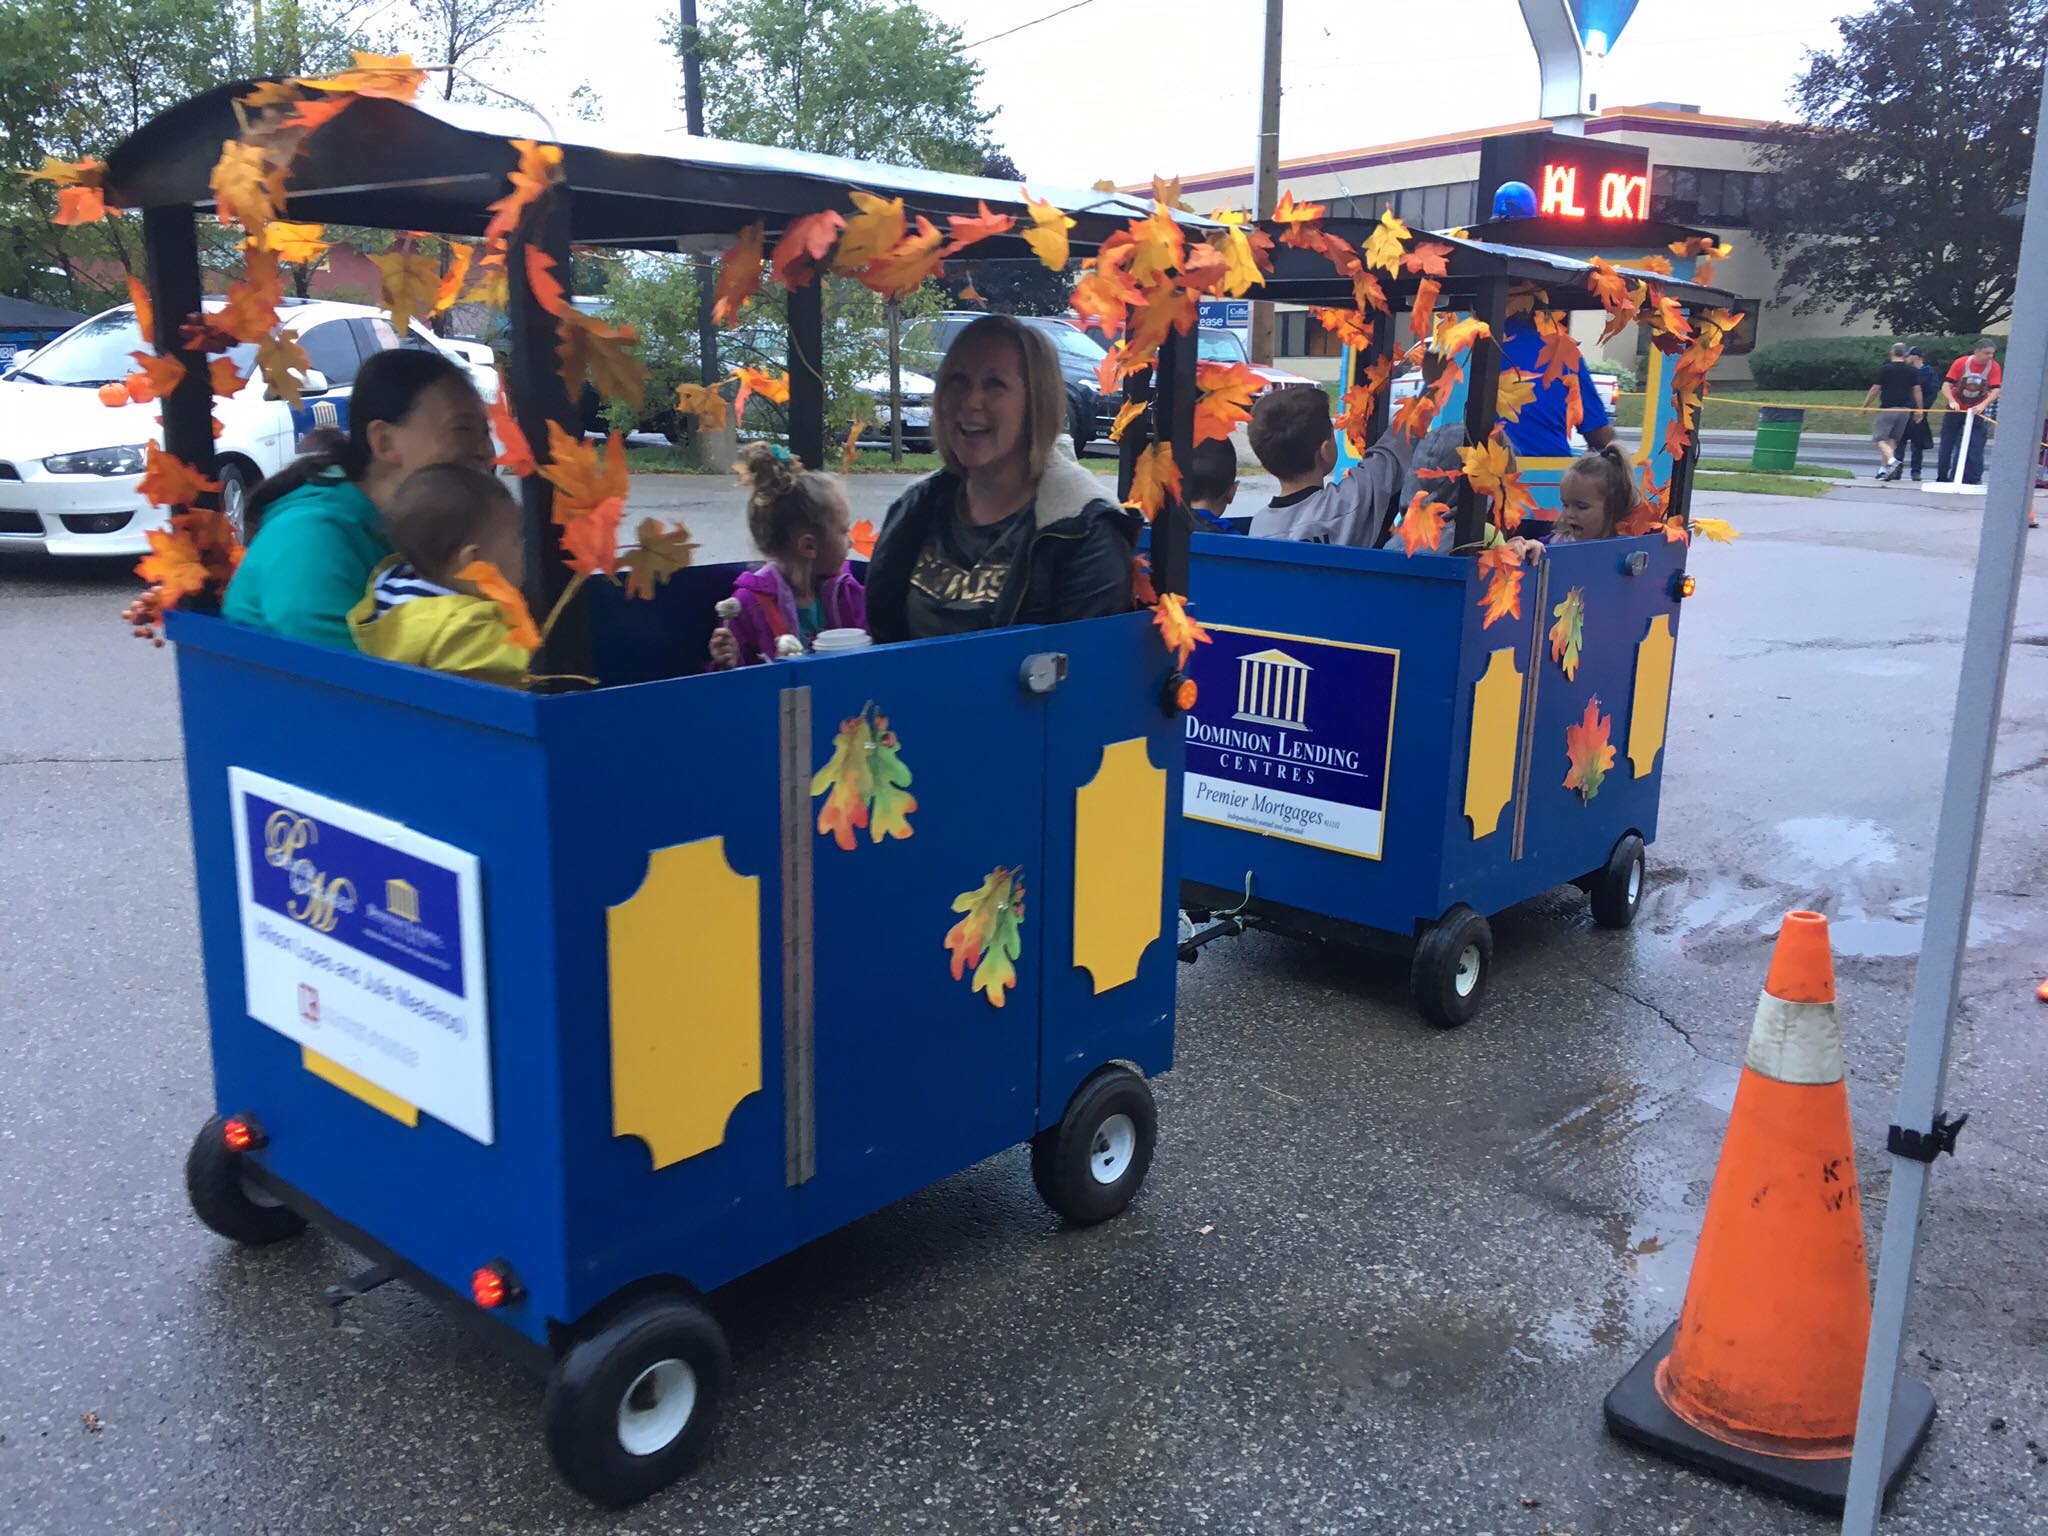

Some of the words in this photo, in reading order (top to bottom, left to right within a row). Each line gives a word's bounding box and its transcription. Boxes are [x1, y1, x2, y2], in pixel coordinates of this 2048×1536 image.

[1200, 306, 1211, 315] or
[1200, 318, 1224, 327] ease
[1185, 715, 1272, 753] DOMINION
[1278, 731, 1360, 769] LENDING
[1219, 752, 1316, 785] CENTRES
[1196, 781, 1249, 808] Premier
[1251, 793, 1324, 827] Mortgages
